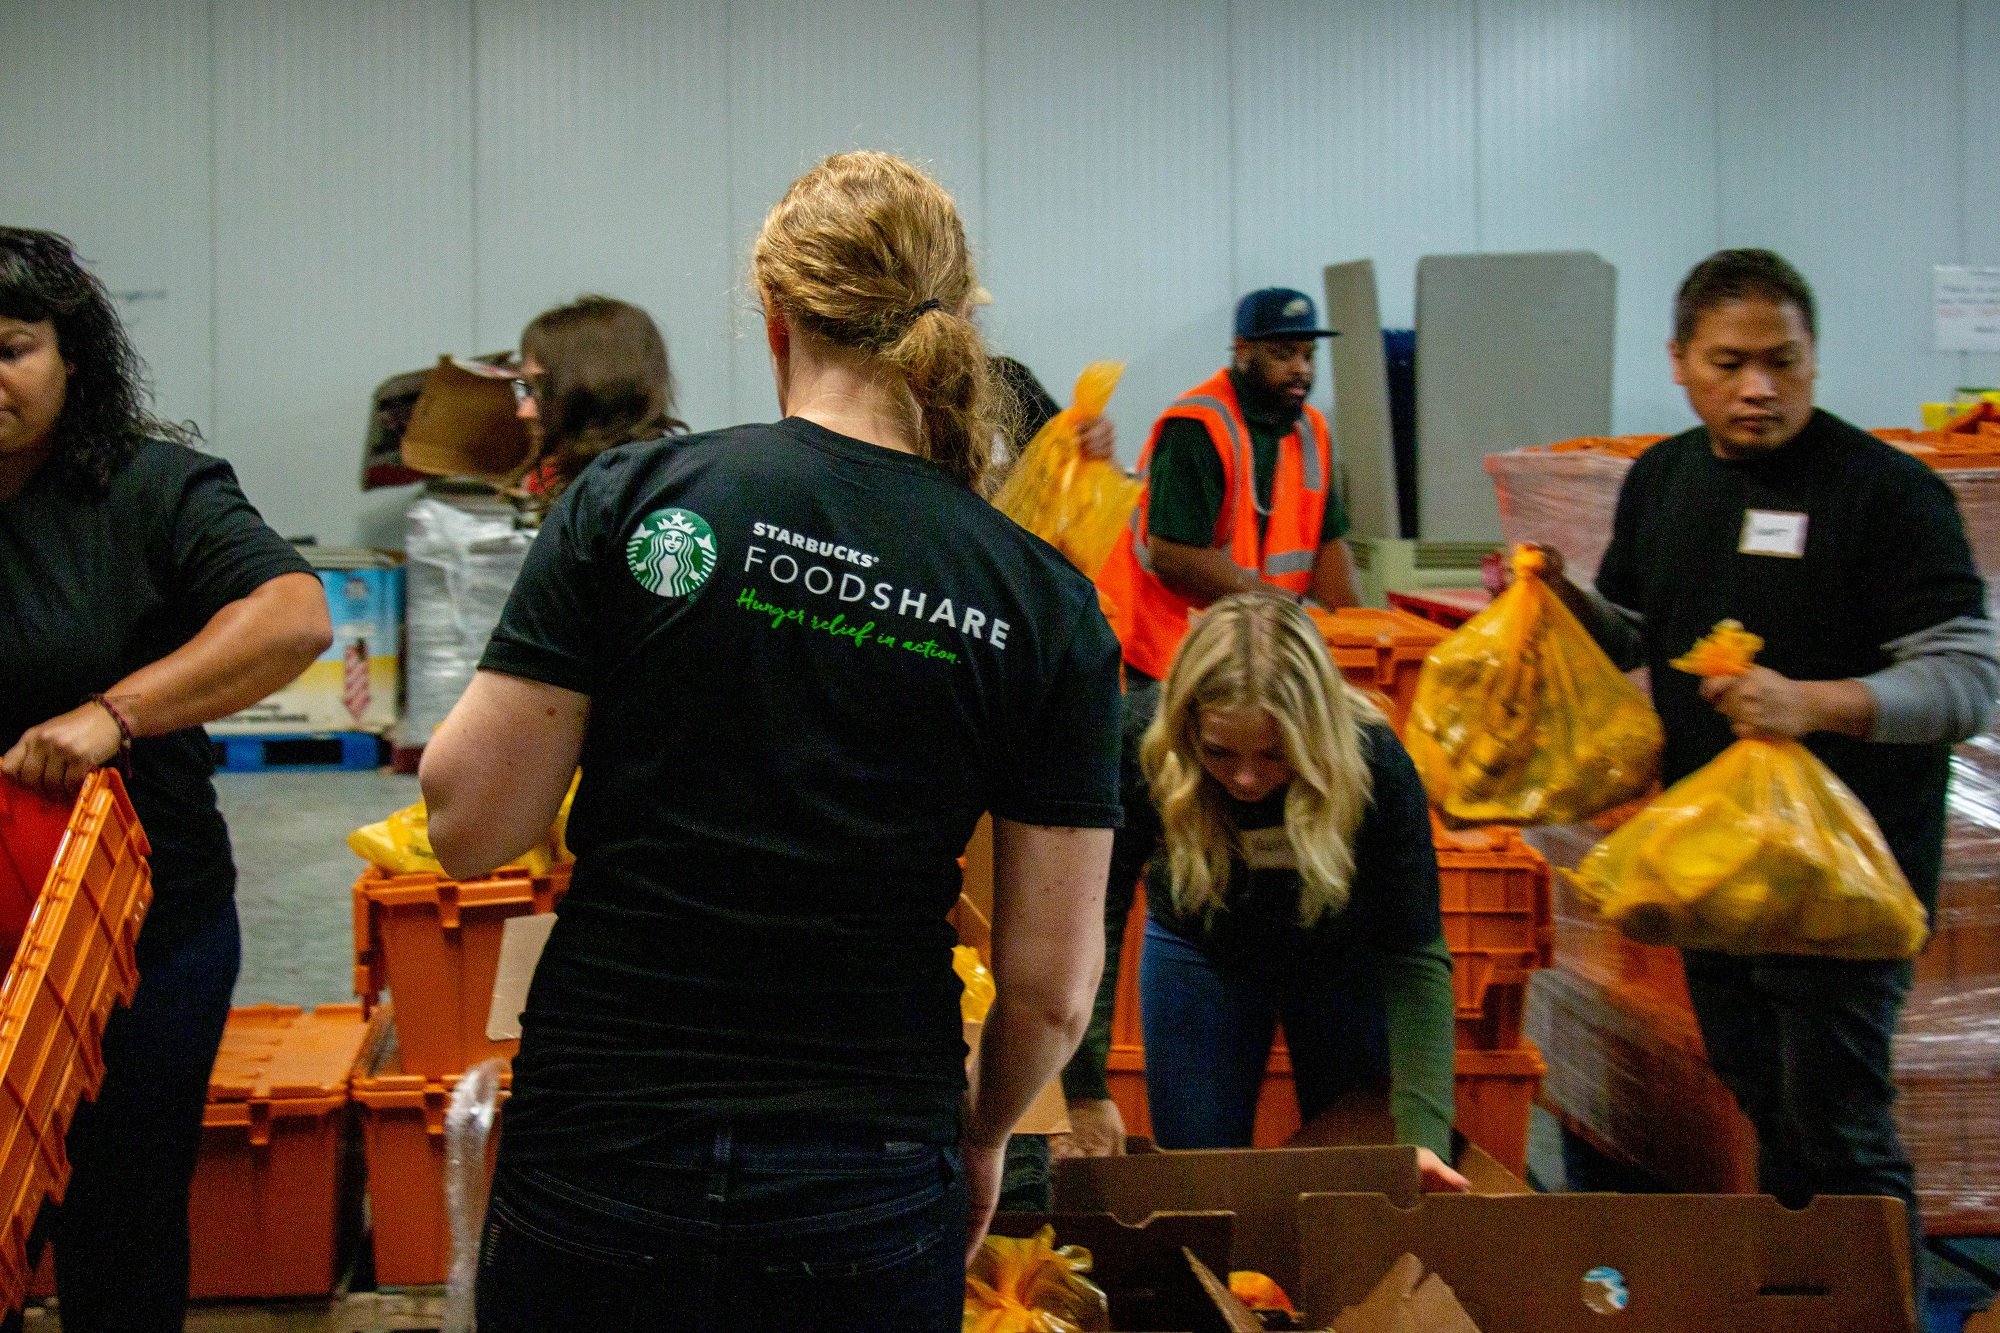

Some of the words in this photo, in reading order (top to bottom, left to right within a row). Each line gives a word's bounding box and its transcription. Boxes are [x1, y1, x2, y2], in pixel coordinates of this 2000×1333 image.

[736, 588, 805, 629] Hunger
[811, 613, 875, 648] relief
[877, 633, 896, 648] in
[902, 639, 961, 665] action.
[744, 545, 1011, 650] FOODSHARE
